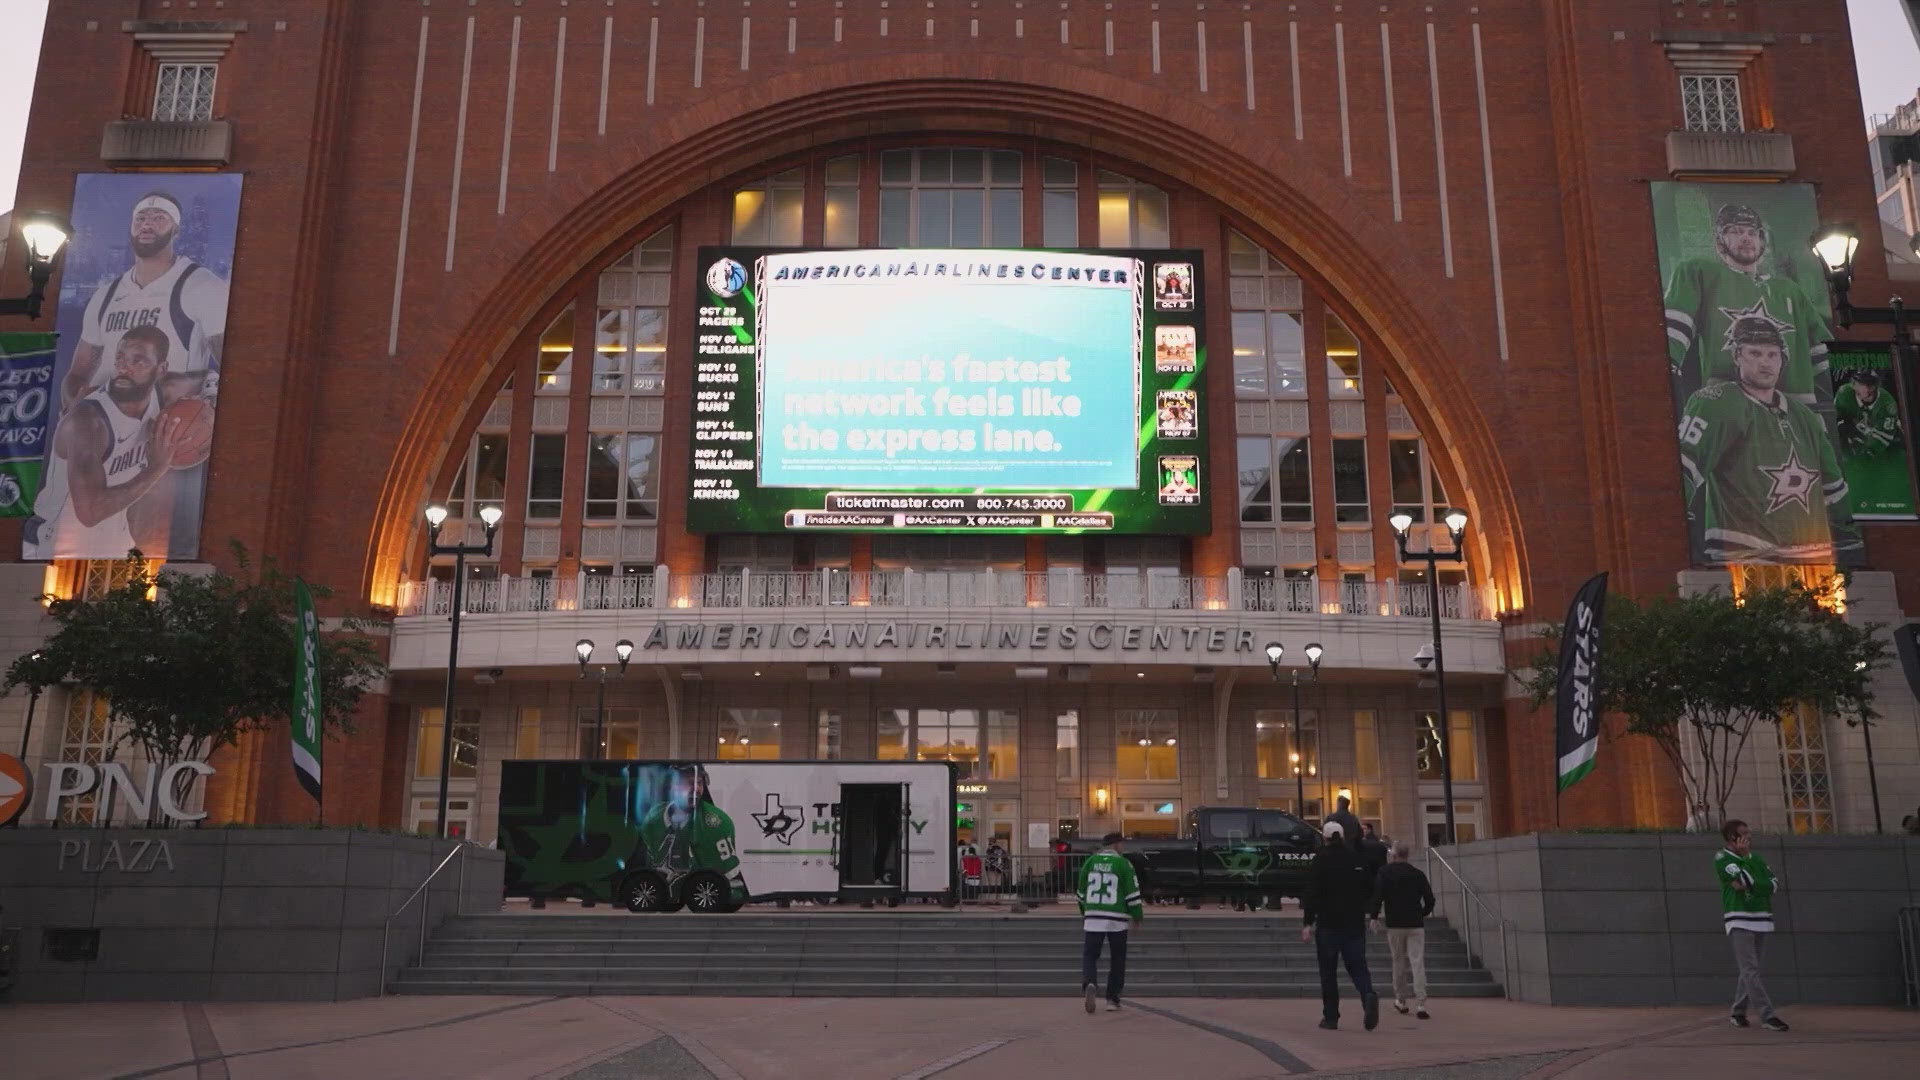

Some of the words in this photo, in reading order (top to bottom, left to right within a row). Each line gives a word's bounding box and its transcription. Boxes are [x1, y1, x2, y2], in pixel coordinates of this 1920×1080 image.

[699, 306, 722, 316] OCT
[699, 317, 745, 326] PACERS
[699, 334, 723, 344] NOV
[698, 344, 756, 354] PELICANS
[698, 363, 722, 372] NOV
[950, 353, 1072, 383] fastest
[697, 373, 739, 383] BUCKS
[697, 391, 722, 401] NOV
[784, 387, 926, 417] network
[932, 386, 1016, 417] feels
[1021, 386, 1083, 417] like
[697, 401, 730, 412] SUNS
[696, 420, 721, 430] NOV
[695, 430, 754, 441] CLIPPERS
[783, 420, 839, 451] the
[846, 427, 976, 458] express
[983, 421, 1065, 452] lane.
[695, 449, 720, 459] NOV
[693, 478, 719, 488] NOV
[693, 489, 740, 500] KNICKS
[836, 496, 965, 509] ticketmaster.com
[976, 498, 1067, 510] 800.745.3000
[1573, 600, 1594, 738] STARS
[45, 759, 217, 821] PNC
[58, 839, 174, 872] PLAZA
[1086, 872, 1120, 905] 23
